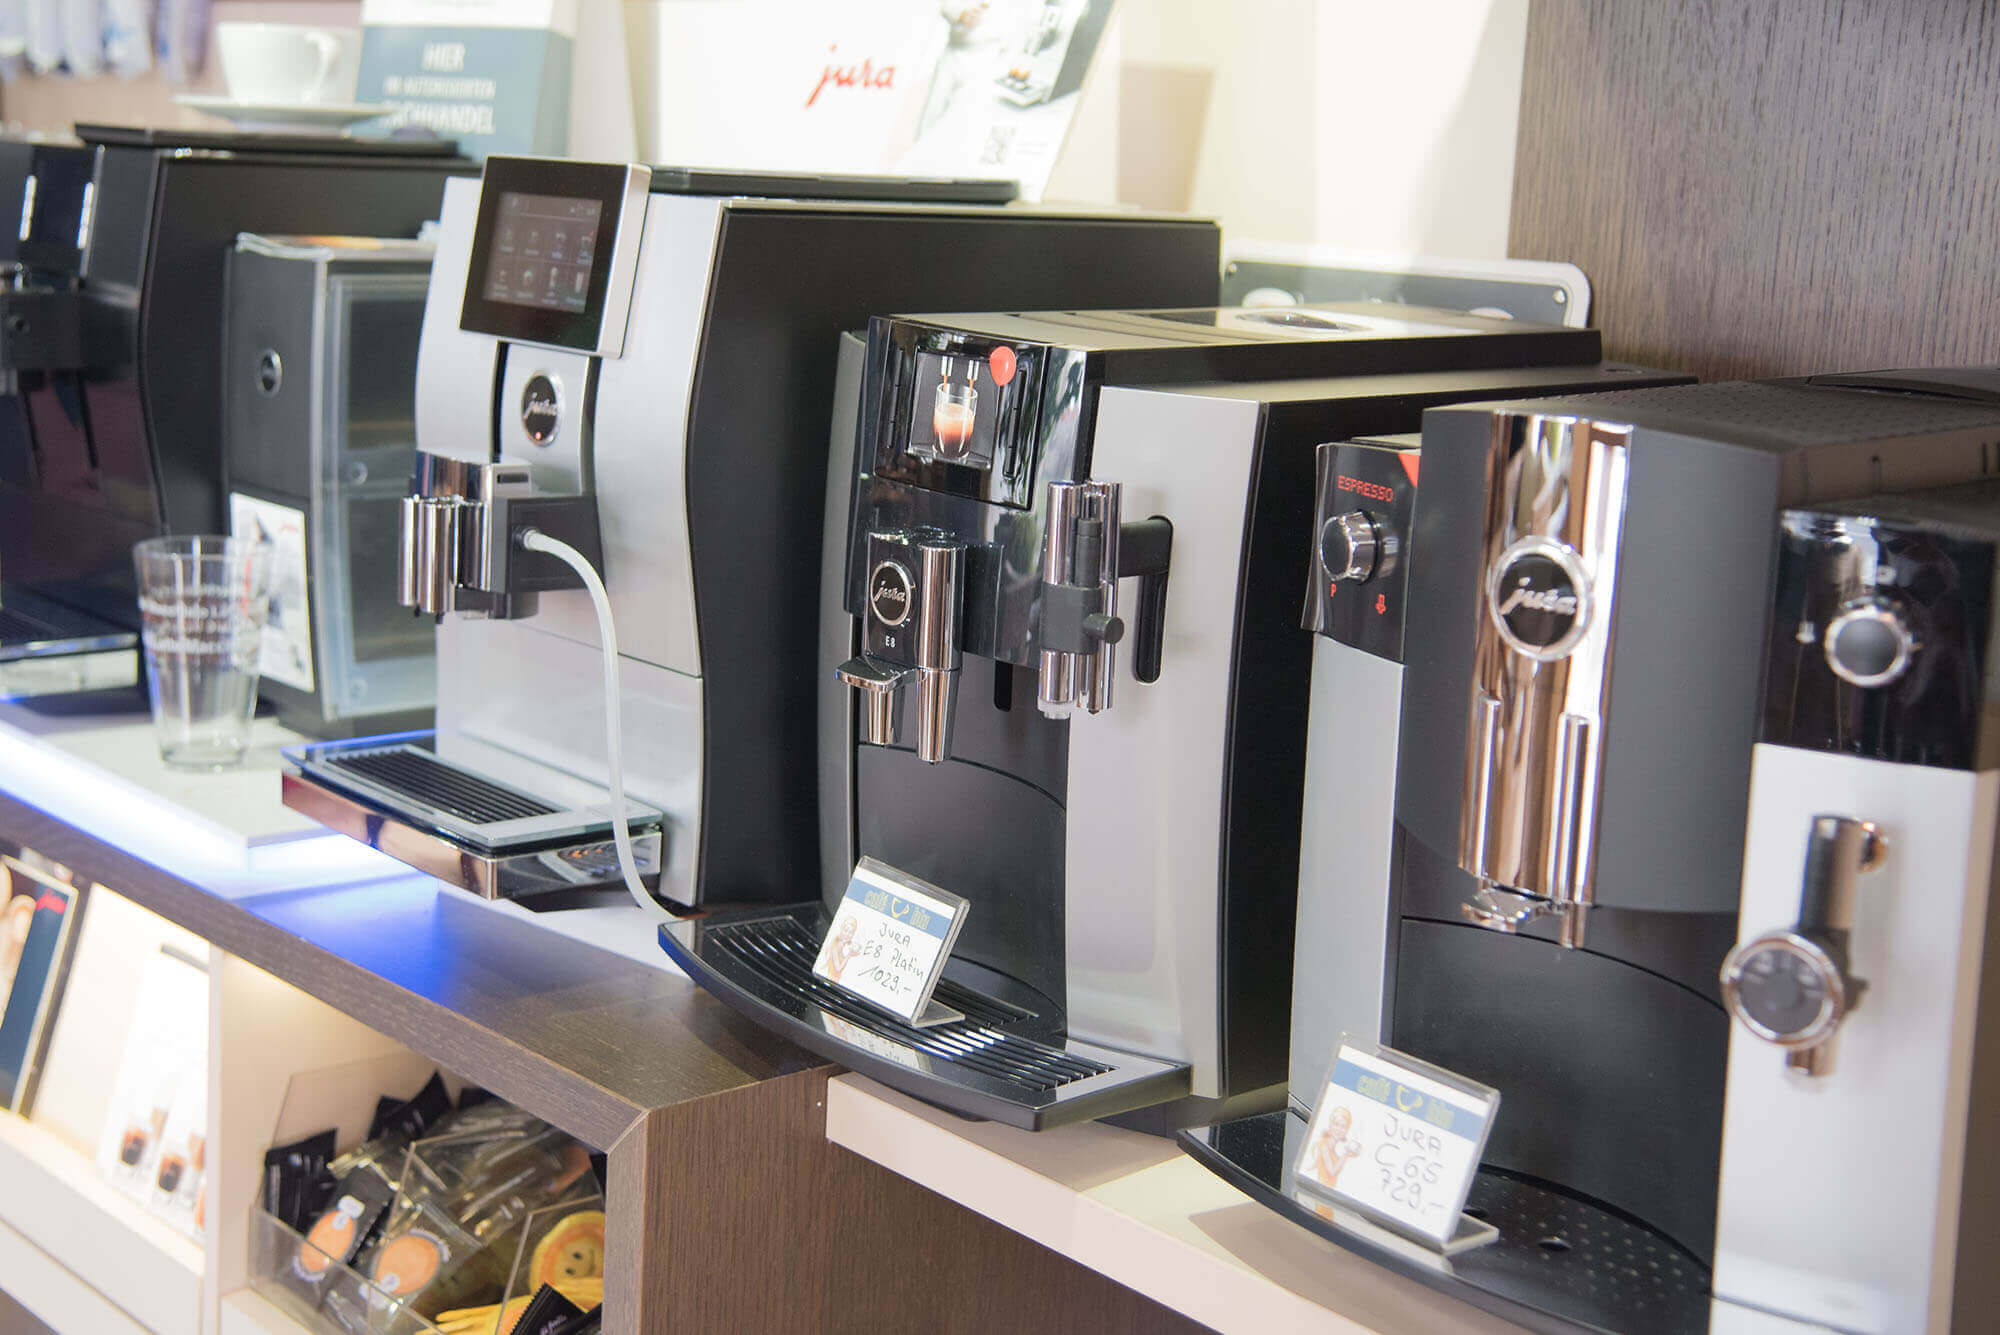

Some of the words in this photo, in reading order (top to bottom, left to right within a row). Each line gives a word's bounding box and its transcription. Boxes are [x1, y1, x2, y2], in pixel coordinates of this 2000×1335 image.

[421, 41, 467, 72] HIER
[806, 43, 896, 109] jura
[1337, 475, 1395, 503] ESPRESSO
[874, 580, 906, 602] jura
[1499, 576, 1577, 616] jura
[880, 921, 911, 946] JURA
[1383, 1112, 1442, 1156] JURA
